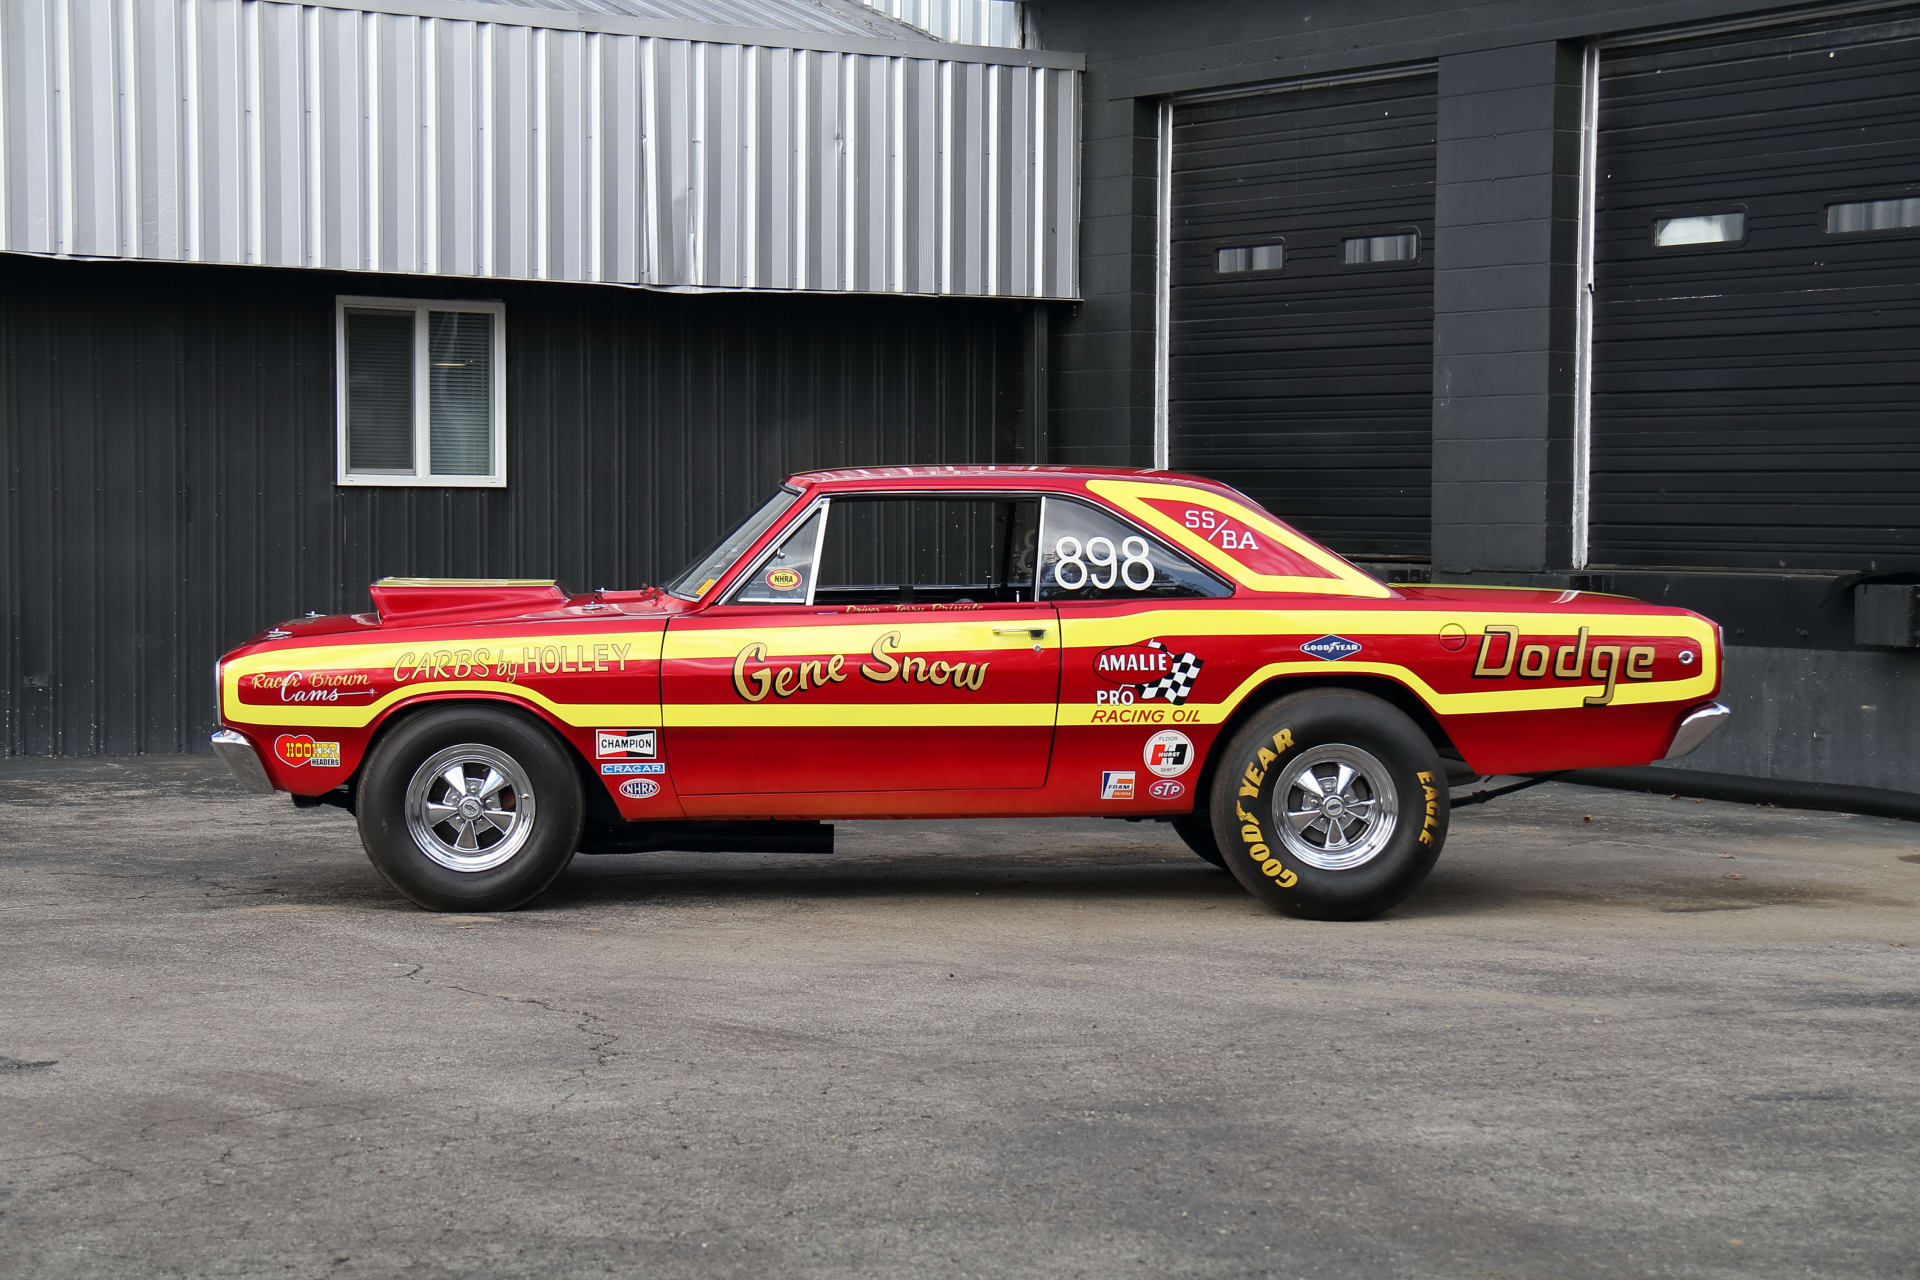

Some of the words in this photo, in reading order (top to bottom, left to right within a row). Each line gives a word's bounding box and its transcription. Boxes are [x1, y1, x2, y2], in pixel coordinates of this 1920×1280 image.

[1054, 535, 1155, 591] 898
[774, 575, 794, 583] NHRA
[392, 648, 491, 682] CARBS
[496, 649, 519, 683] by
[522, 643, 632, 675] HOLLEY
[731, 641, 848, 702] Gene
[860, 630, 990, 691] Snow
[1098, 653, 1168, 671] AMALIE
[1472, 625, 1655, 707] Dodge
[251, 673, 300, 689] Racer
[308, 671, 370, 688] Brown
[280, 671, 339, 702] Cams
[1096, 690, 1134, 706] PRO
[1090, 709, 1166, 723] RACING
[1172, 709, 1201, 723] OIL
[286, 742, 339, 758] HOOKER
[601, 738, 652, 749] CHAMPION
[311, 758, 340, 766] HEADERS
[603, 764, 661, 773] CRAGAR
[626, 782, 655, 795] NHRA
[1153, 782, 1180, 797] STP
[1416, 770, 1441, 849] EAGLE
